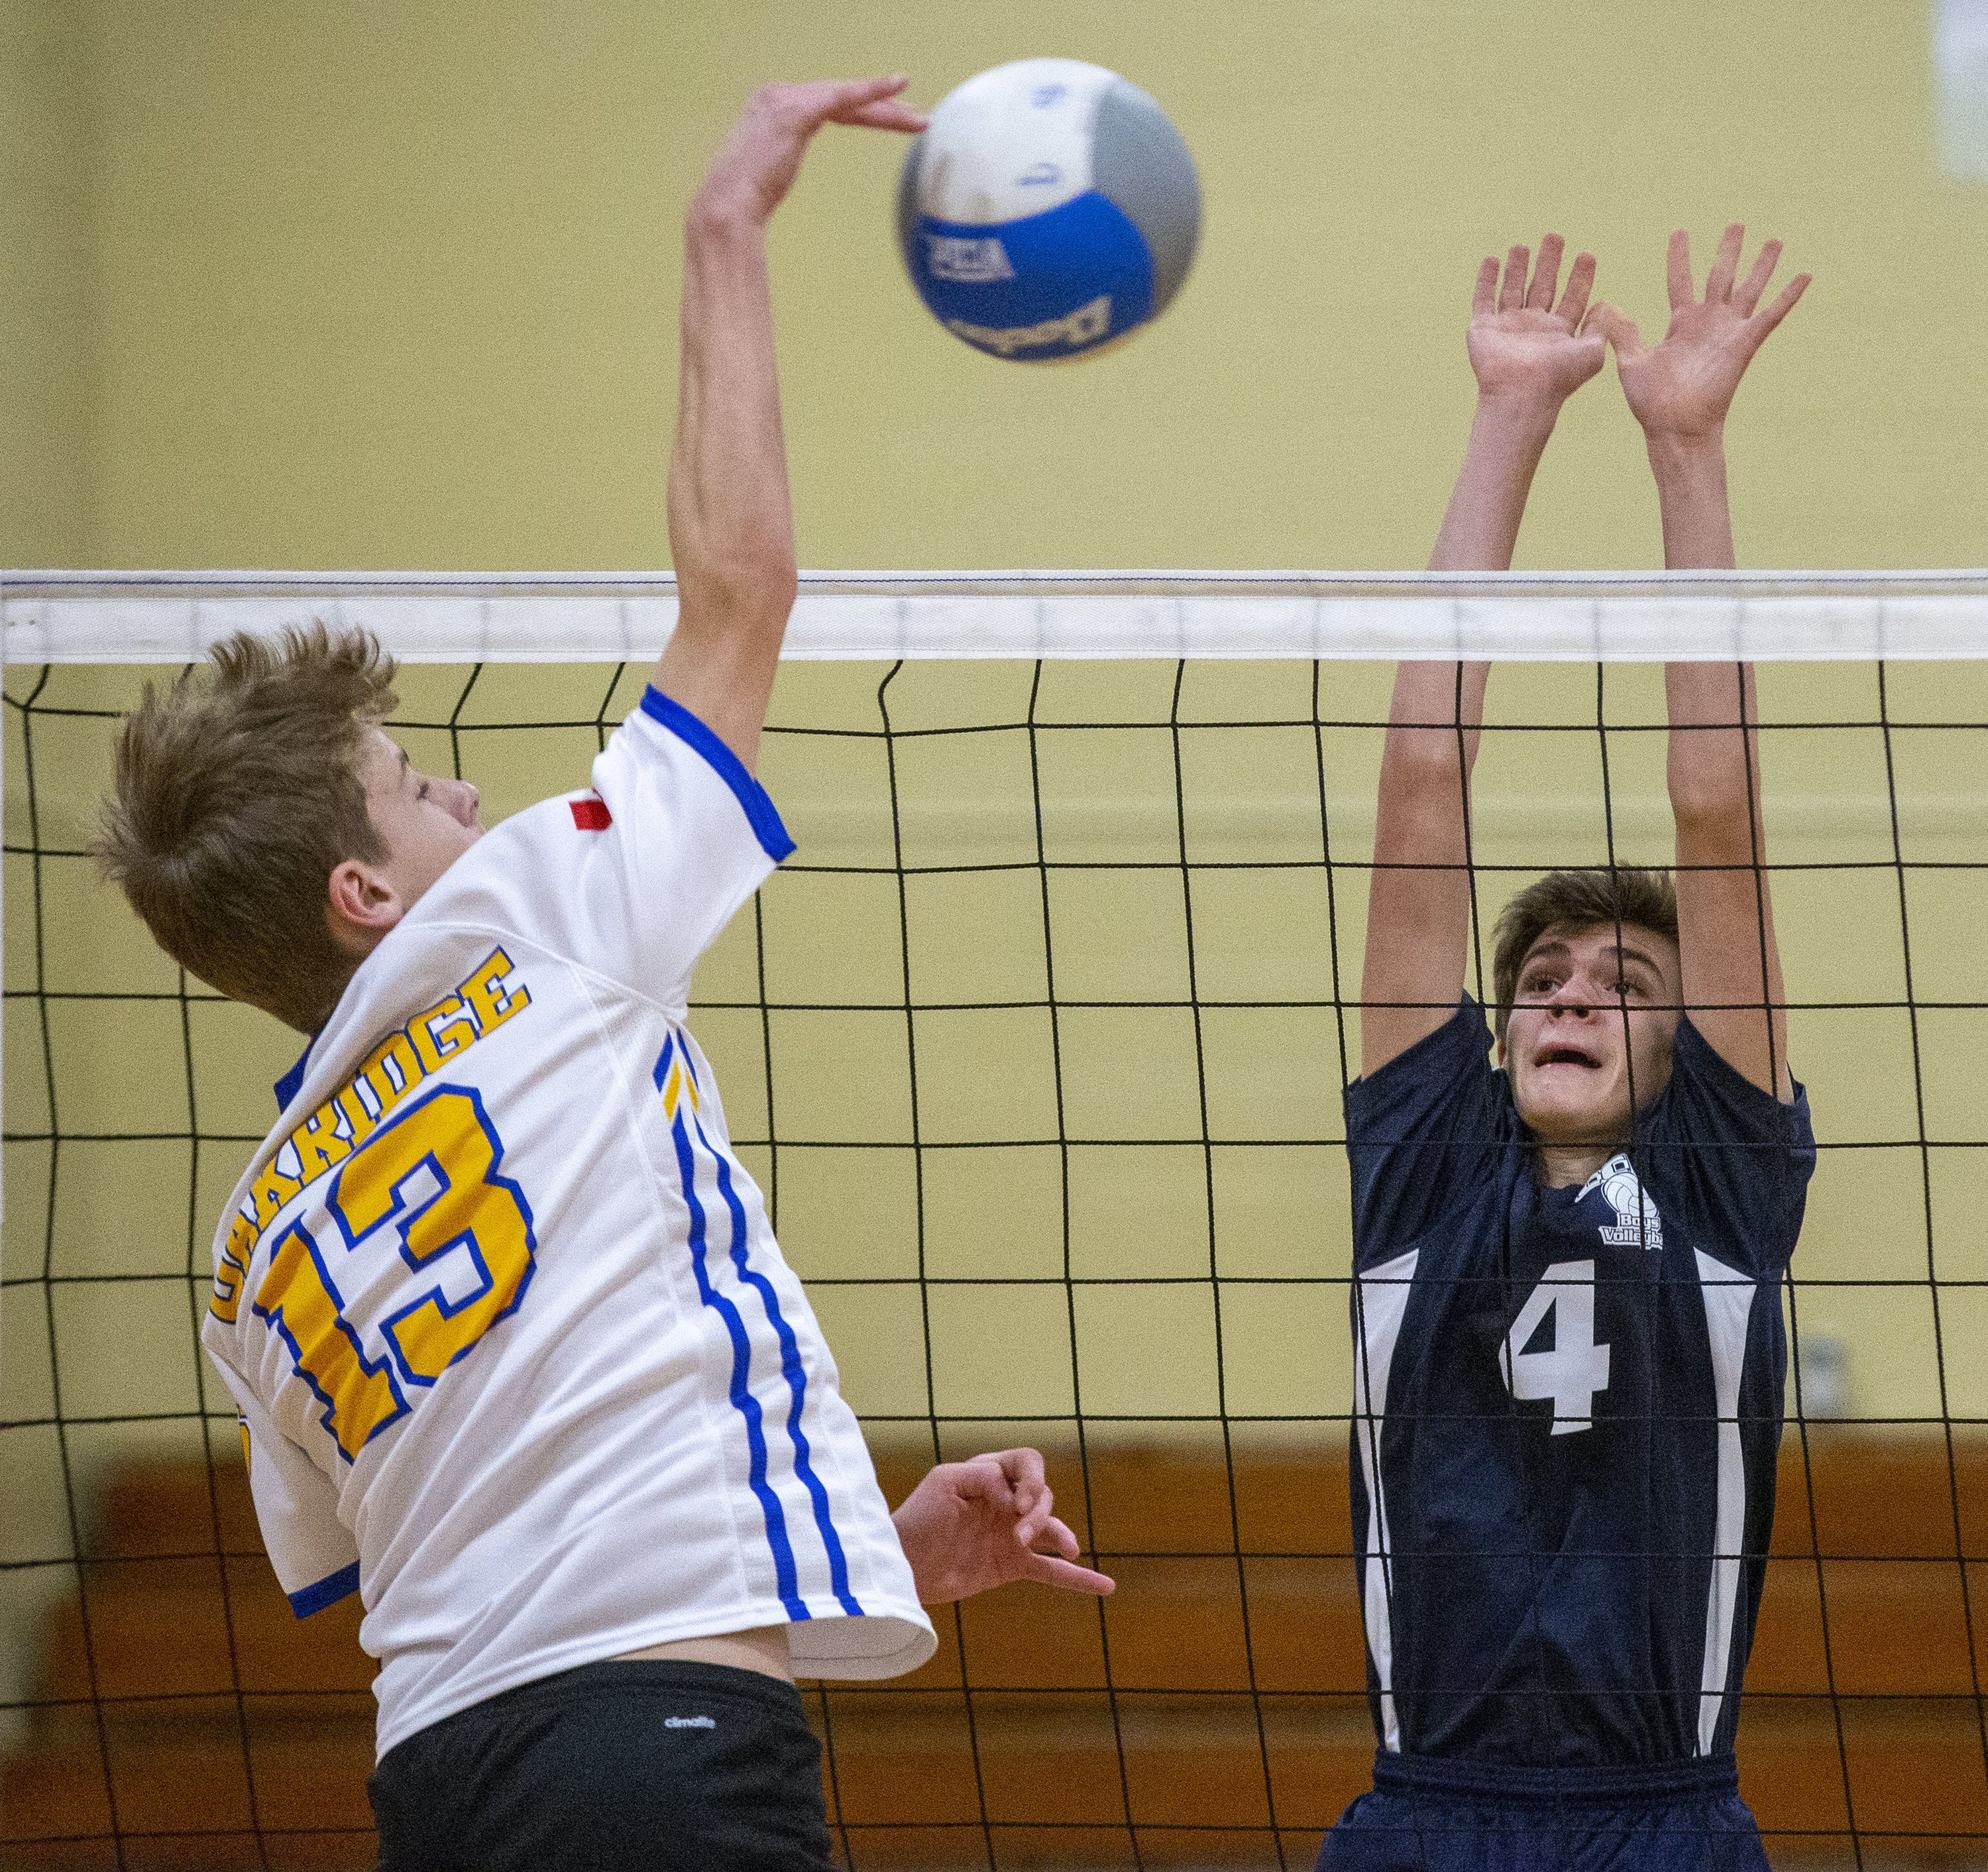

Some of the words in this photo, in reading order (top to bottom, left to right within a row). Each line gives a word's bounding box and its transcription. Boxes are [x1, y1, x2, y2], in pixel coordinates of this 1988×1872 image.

[253, 1082, 537, 1465] 13
[1620, 1213, 1659, 1230] Boys
[1498, 1260, 1610, 1435] 4
